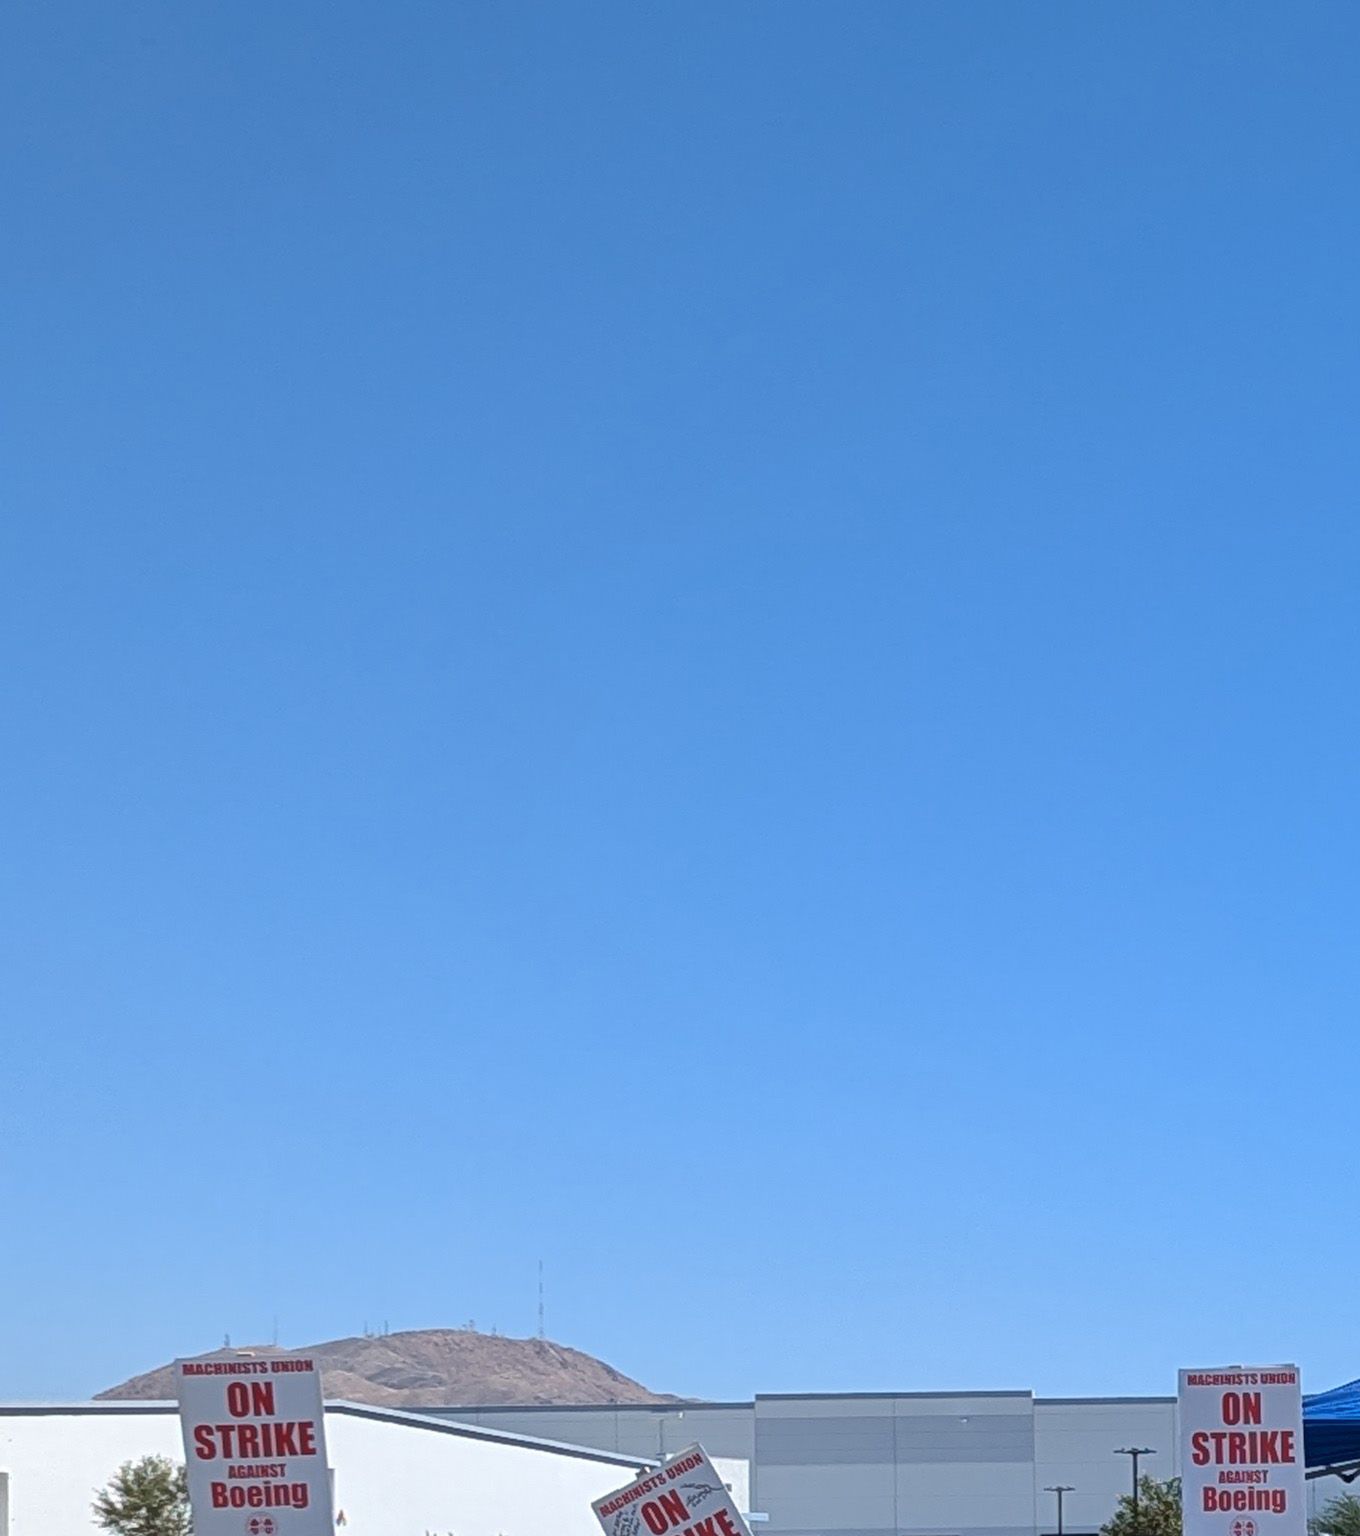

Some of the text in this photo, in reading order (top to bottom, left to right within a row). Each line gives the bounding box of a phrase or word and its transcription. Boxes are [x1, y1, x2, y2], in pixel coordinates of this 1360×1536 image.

[182, 1360, 314, 1376] MACHINISTS UNION
[227, 1381, 275, 1418] ON
[1222, 1391, 1262, 1426] ON
[194, 1421, 317, 1460] STRIKE
[1191, 1431, 1296, 1466] STRIKE
[228, 1464, 286, 1479] AGAINST
[600, 1472, 666, 1518] MACHINISTS
[666, 1452, 704, 1480] UNION
[1218, 1470, 1269, 1484] AGAINST
[211, 1481, 309, 1509] Boeing
[641, 1488, 691, 1536] ON
[1203, 1485, 1287, 1513] Boeing
